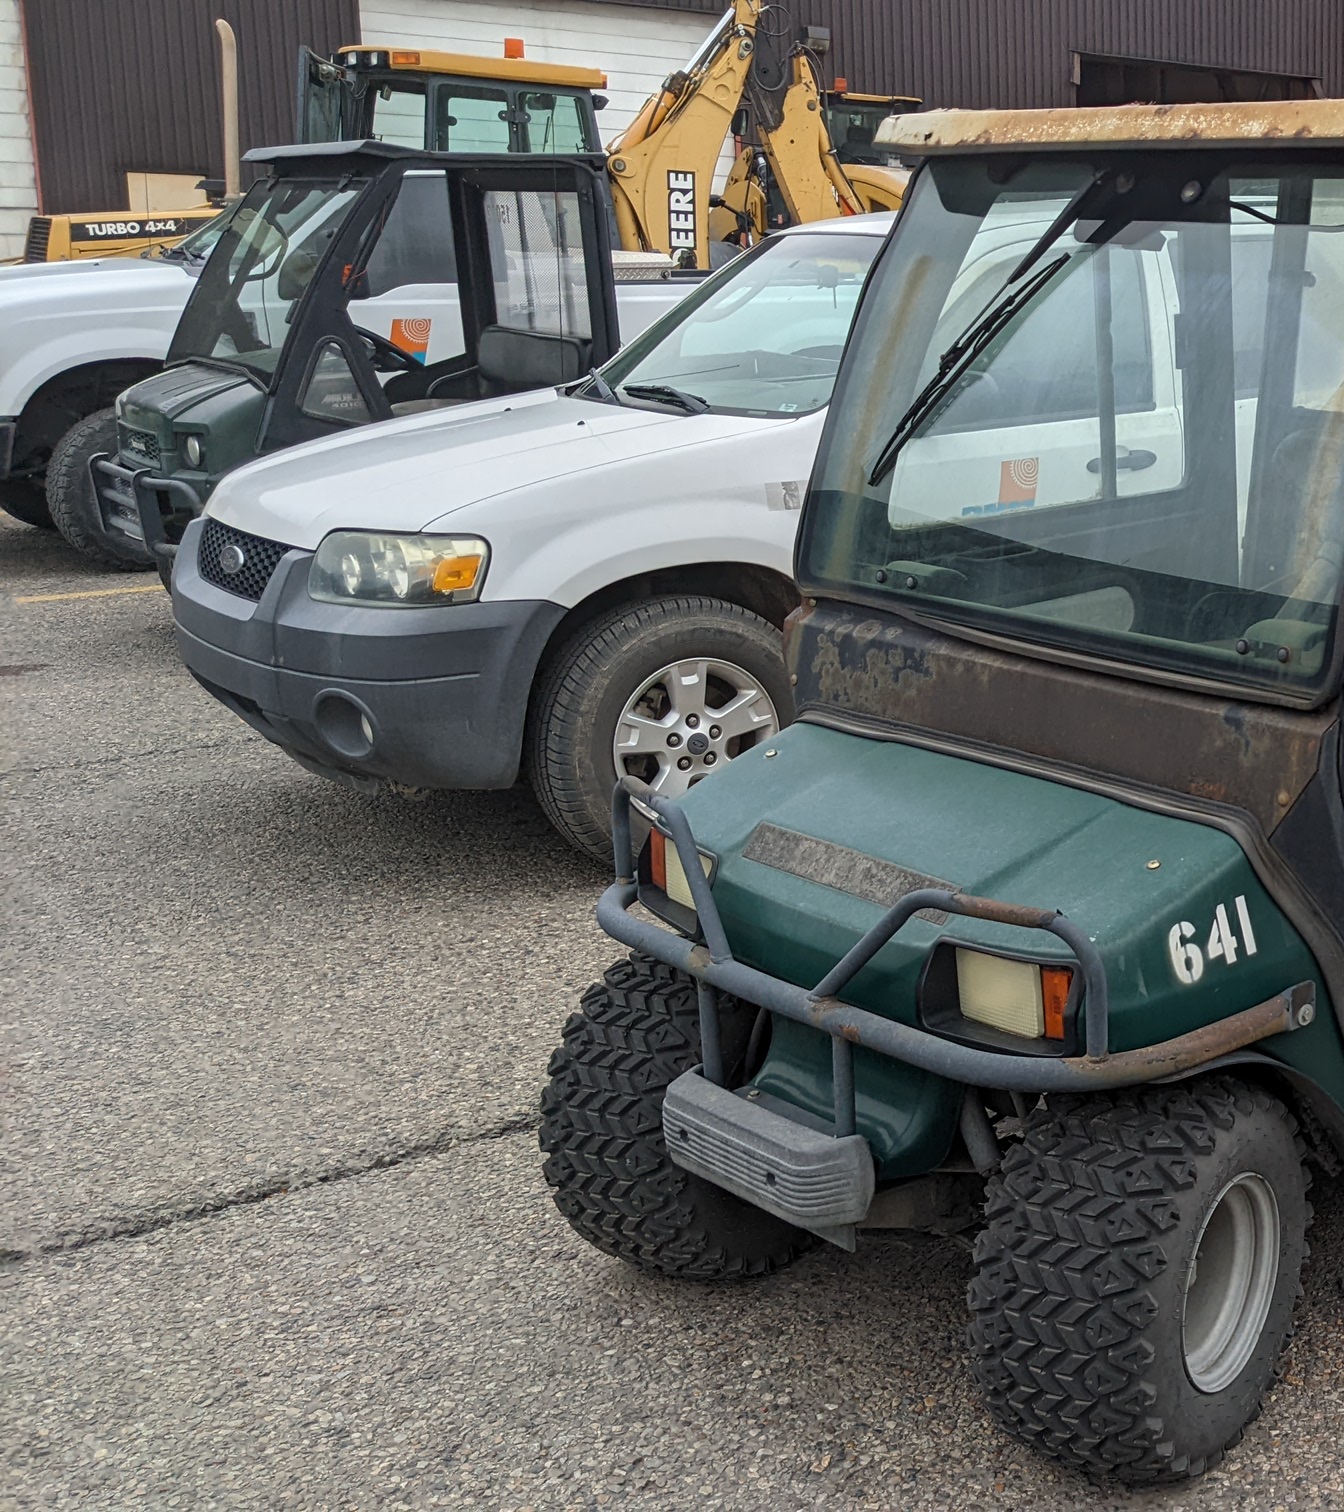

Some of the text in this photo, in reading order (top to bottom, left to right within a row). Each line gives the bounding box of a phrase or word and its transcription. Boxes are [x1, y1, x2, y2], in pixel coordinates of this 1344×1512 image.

[85, 220, 177, 236] TURBO 4x4
[1168, 894, 1257, 984] 641
